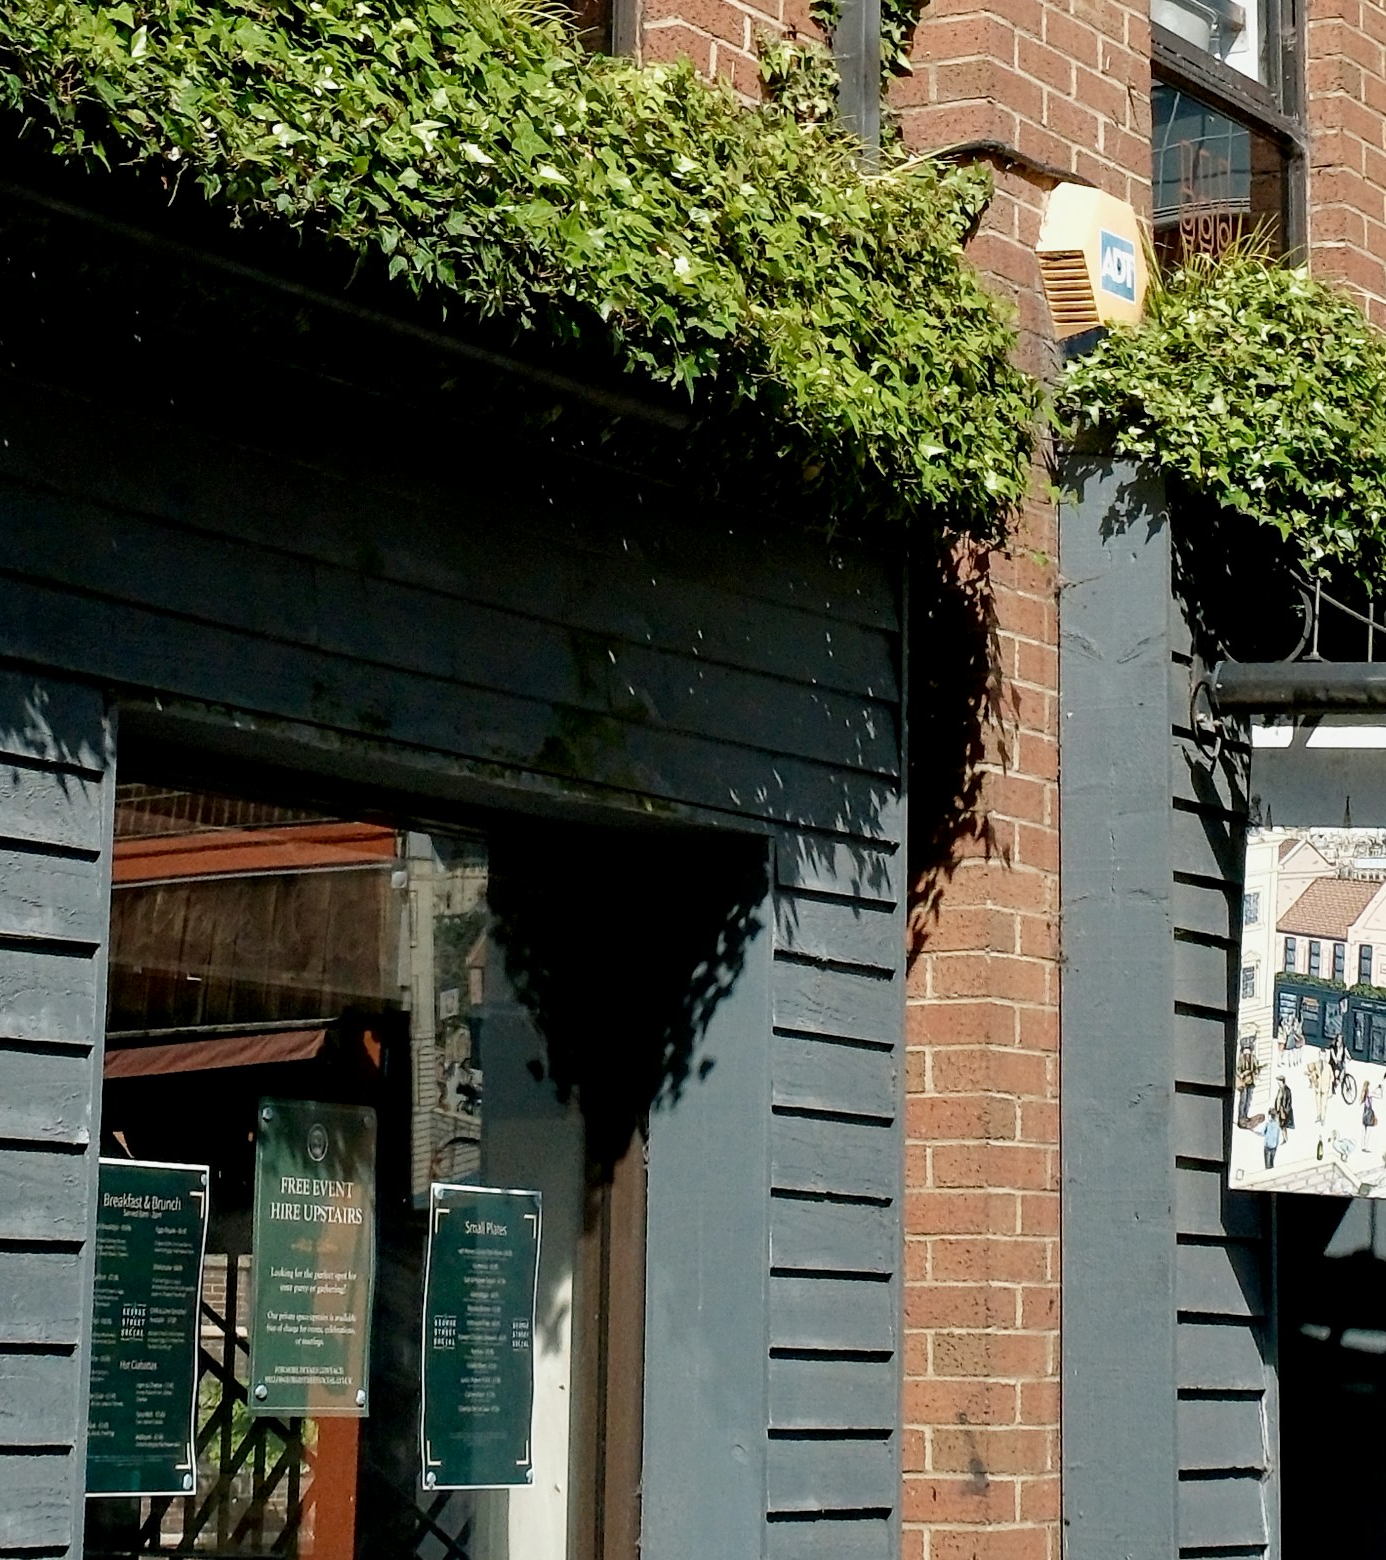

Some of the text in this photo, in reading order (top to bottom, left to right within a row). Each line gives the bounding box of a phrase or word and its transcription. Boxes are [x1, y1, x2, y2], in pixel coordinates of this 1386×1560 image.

[1102, 246, 1135, 289] ADT
[281, 1177, 354, 1199] FREE EVENT
[103, 1193, 182, 1211] Breakfast & Brunch
[270, 1202, 363, 1225] HIRE UPSTAIRS
[465, 1220, 508, 1236] Small Plates
